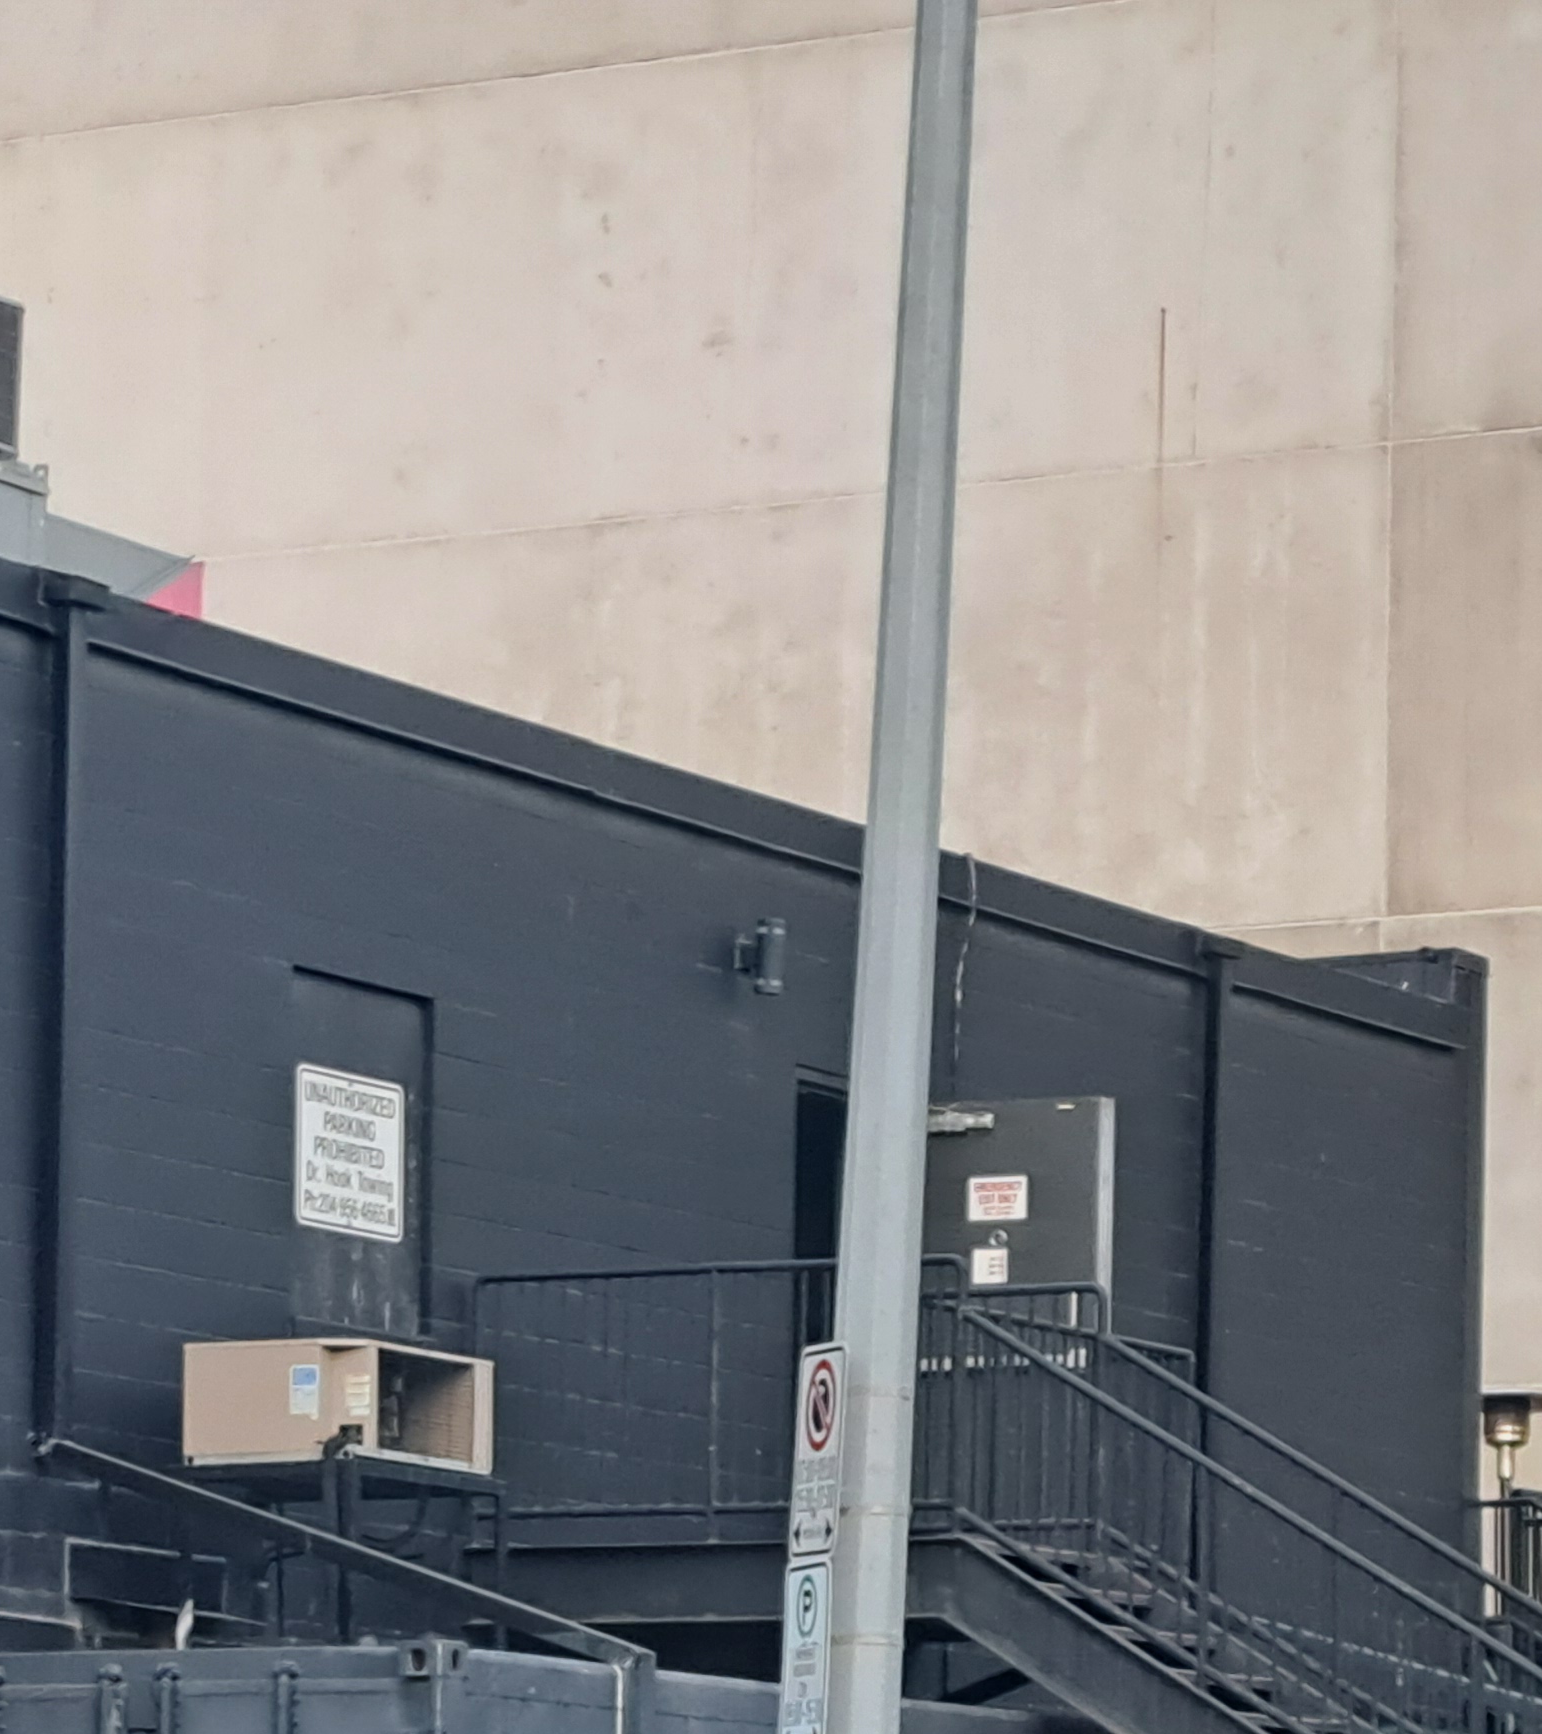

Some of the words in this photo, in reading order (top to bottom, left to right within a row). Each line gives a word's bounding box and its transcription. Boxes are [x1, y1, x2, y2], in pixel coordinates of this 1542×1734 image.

[304, 1081, 397, 1119] UNAUTHORIZED
[323, 1111, 376, 1142] PARKING
[314, 1134, 385, 1169] PROHIBITED
